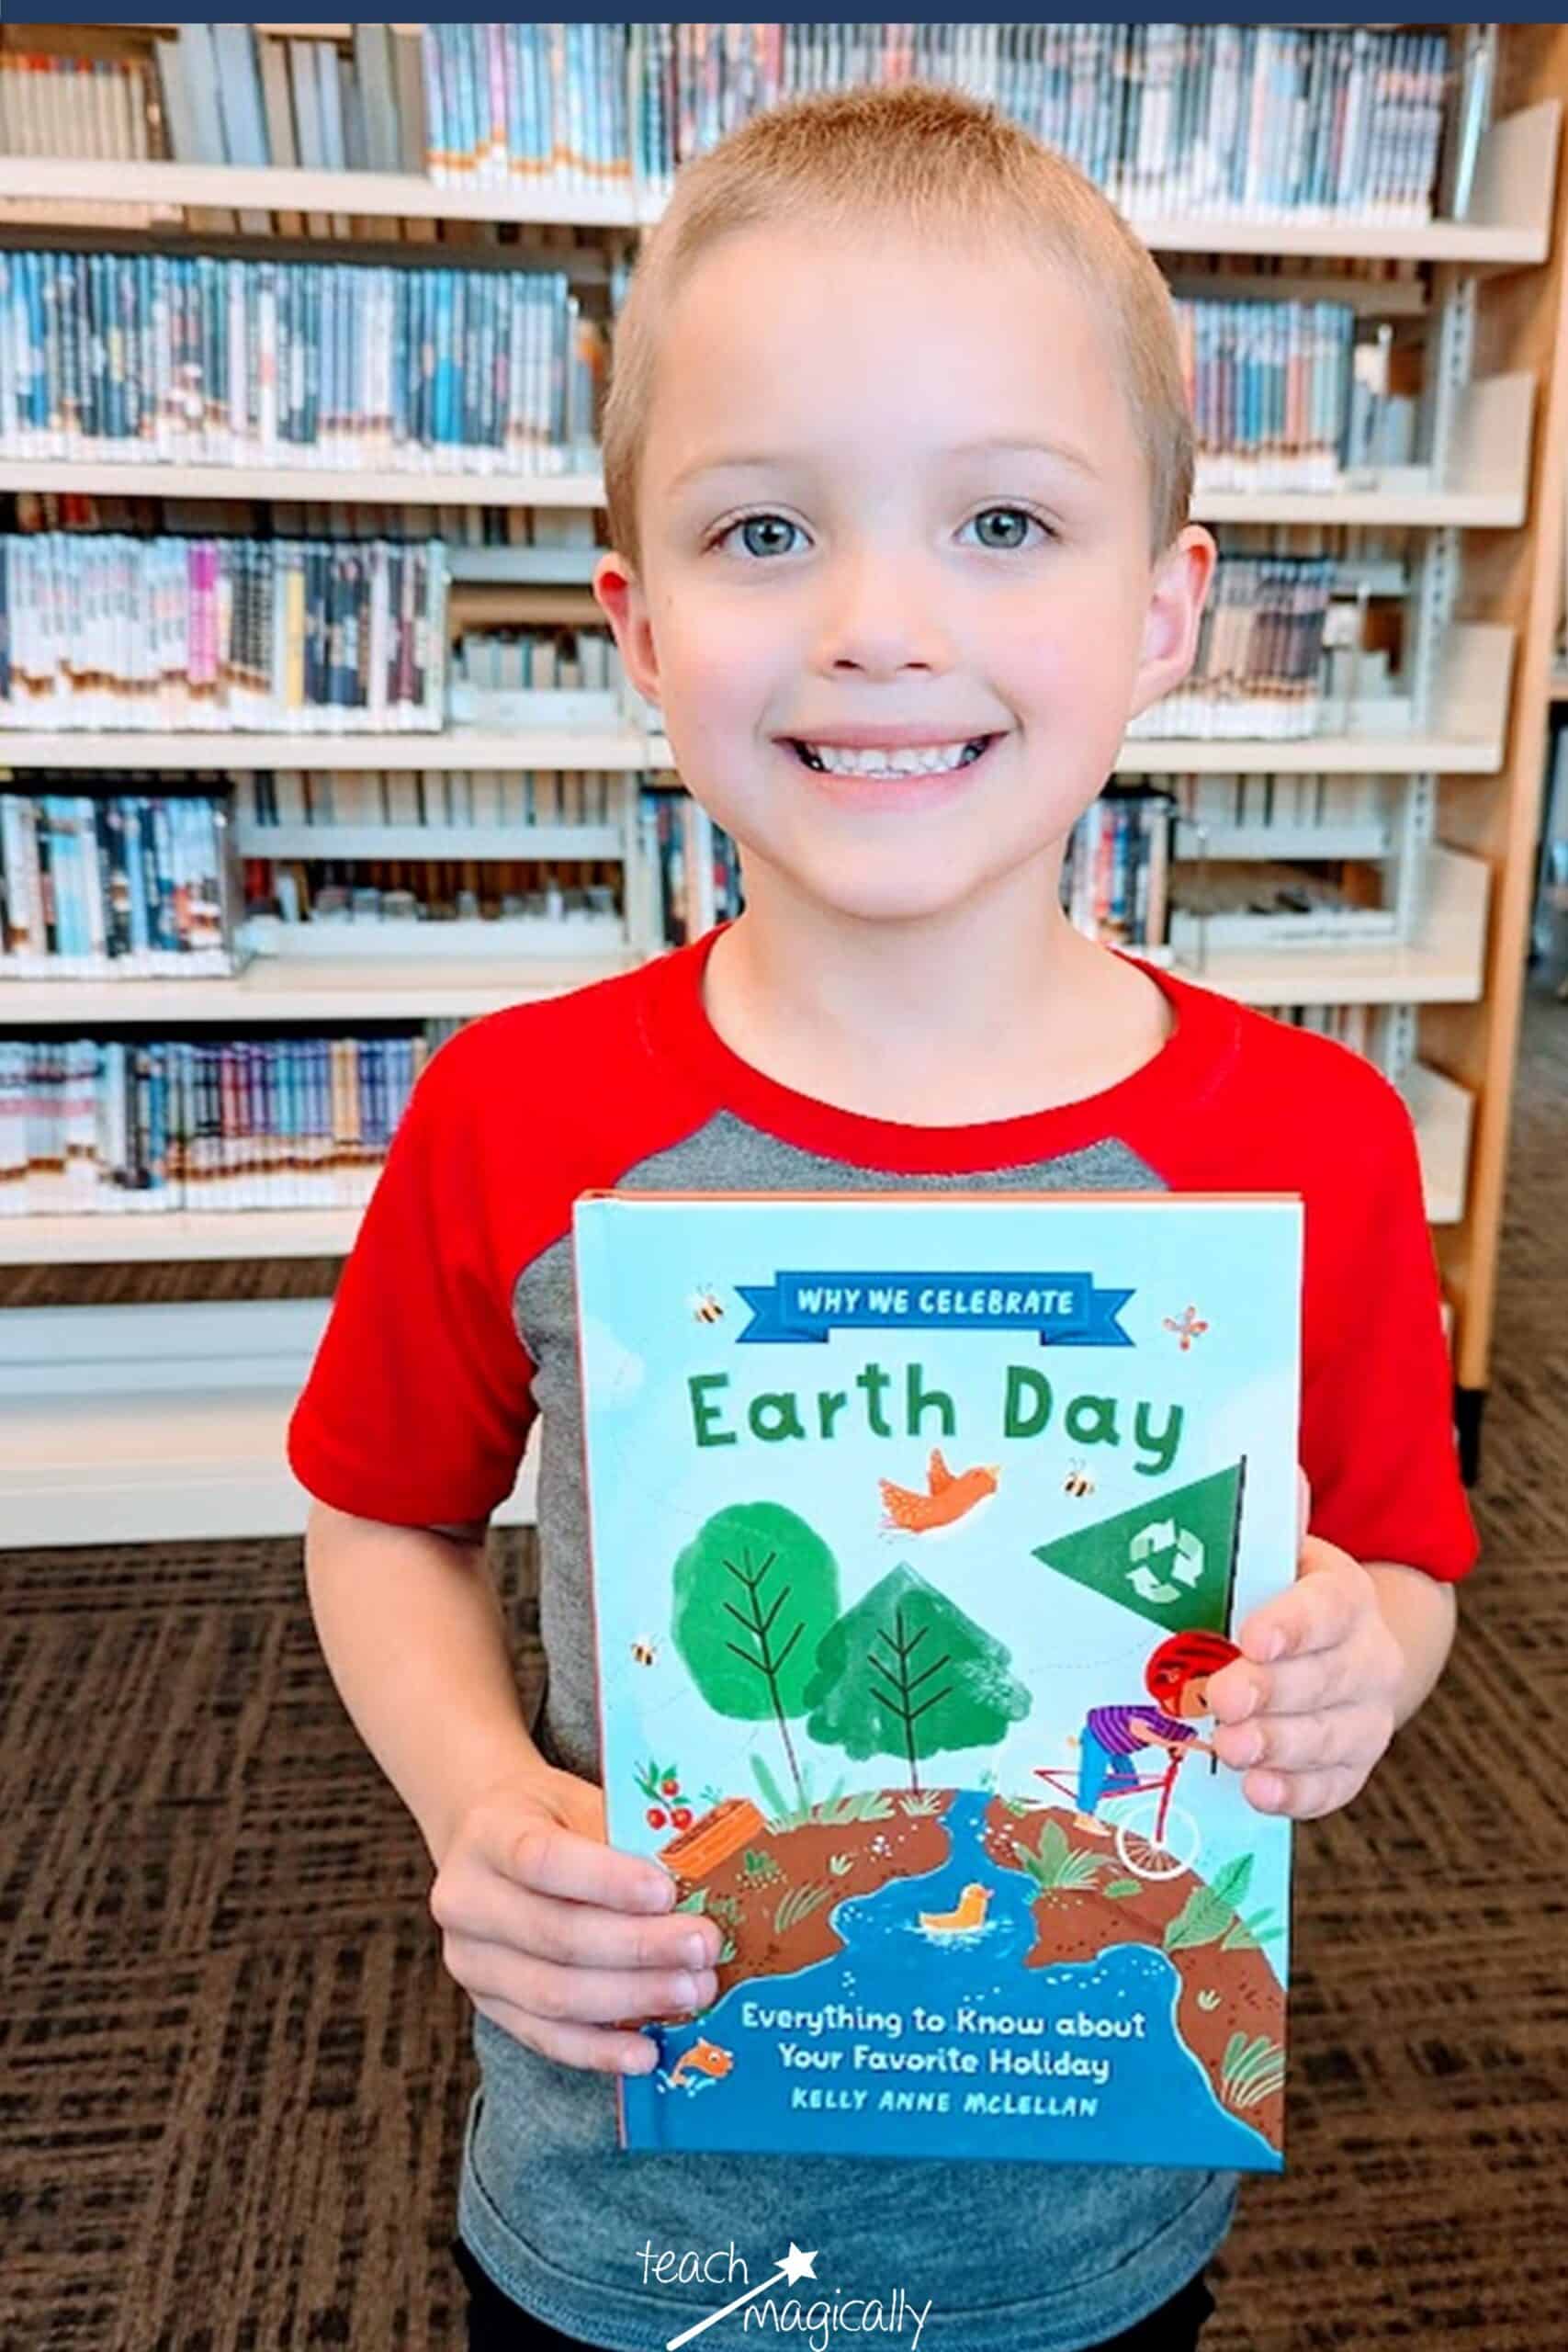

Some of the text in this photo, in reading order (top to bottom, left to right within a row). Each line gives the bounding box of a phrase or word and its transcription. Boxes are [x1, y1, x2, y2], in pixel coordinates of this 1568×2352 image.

[796, 1288, 1074, 1315] WHY WE CELEBRATE
[688, 1363, 1184, 1476] Earth Day
[741, 2002, 1146, 2038] Everything to Know about
[777, 2042, 1111, 2085] Your Favorite Holiday
[791, 2086, 869, 2110] KELLY
[878, 2090, 951, 2113] ANNE
